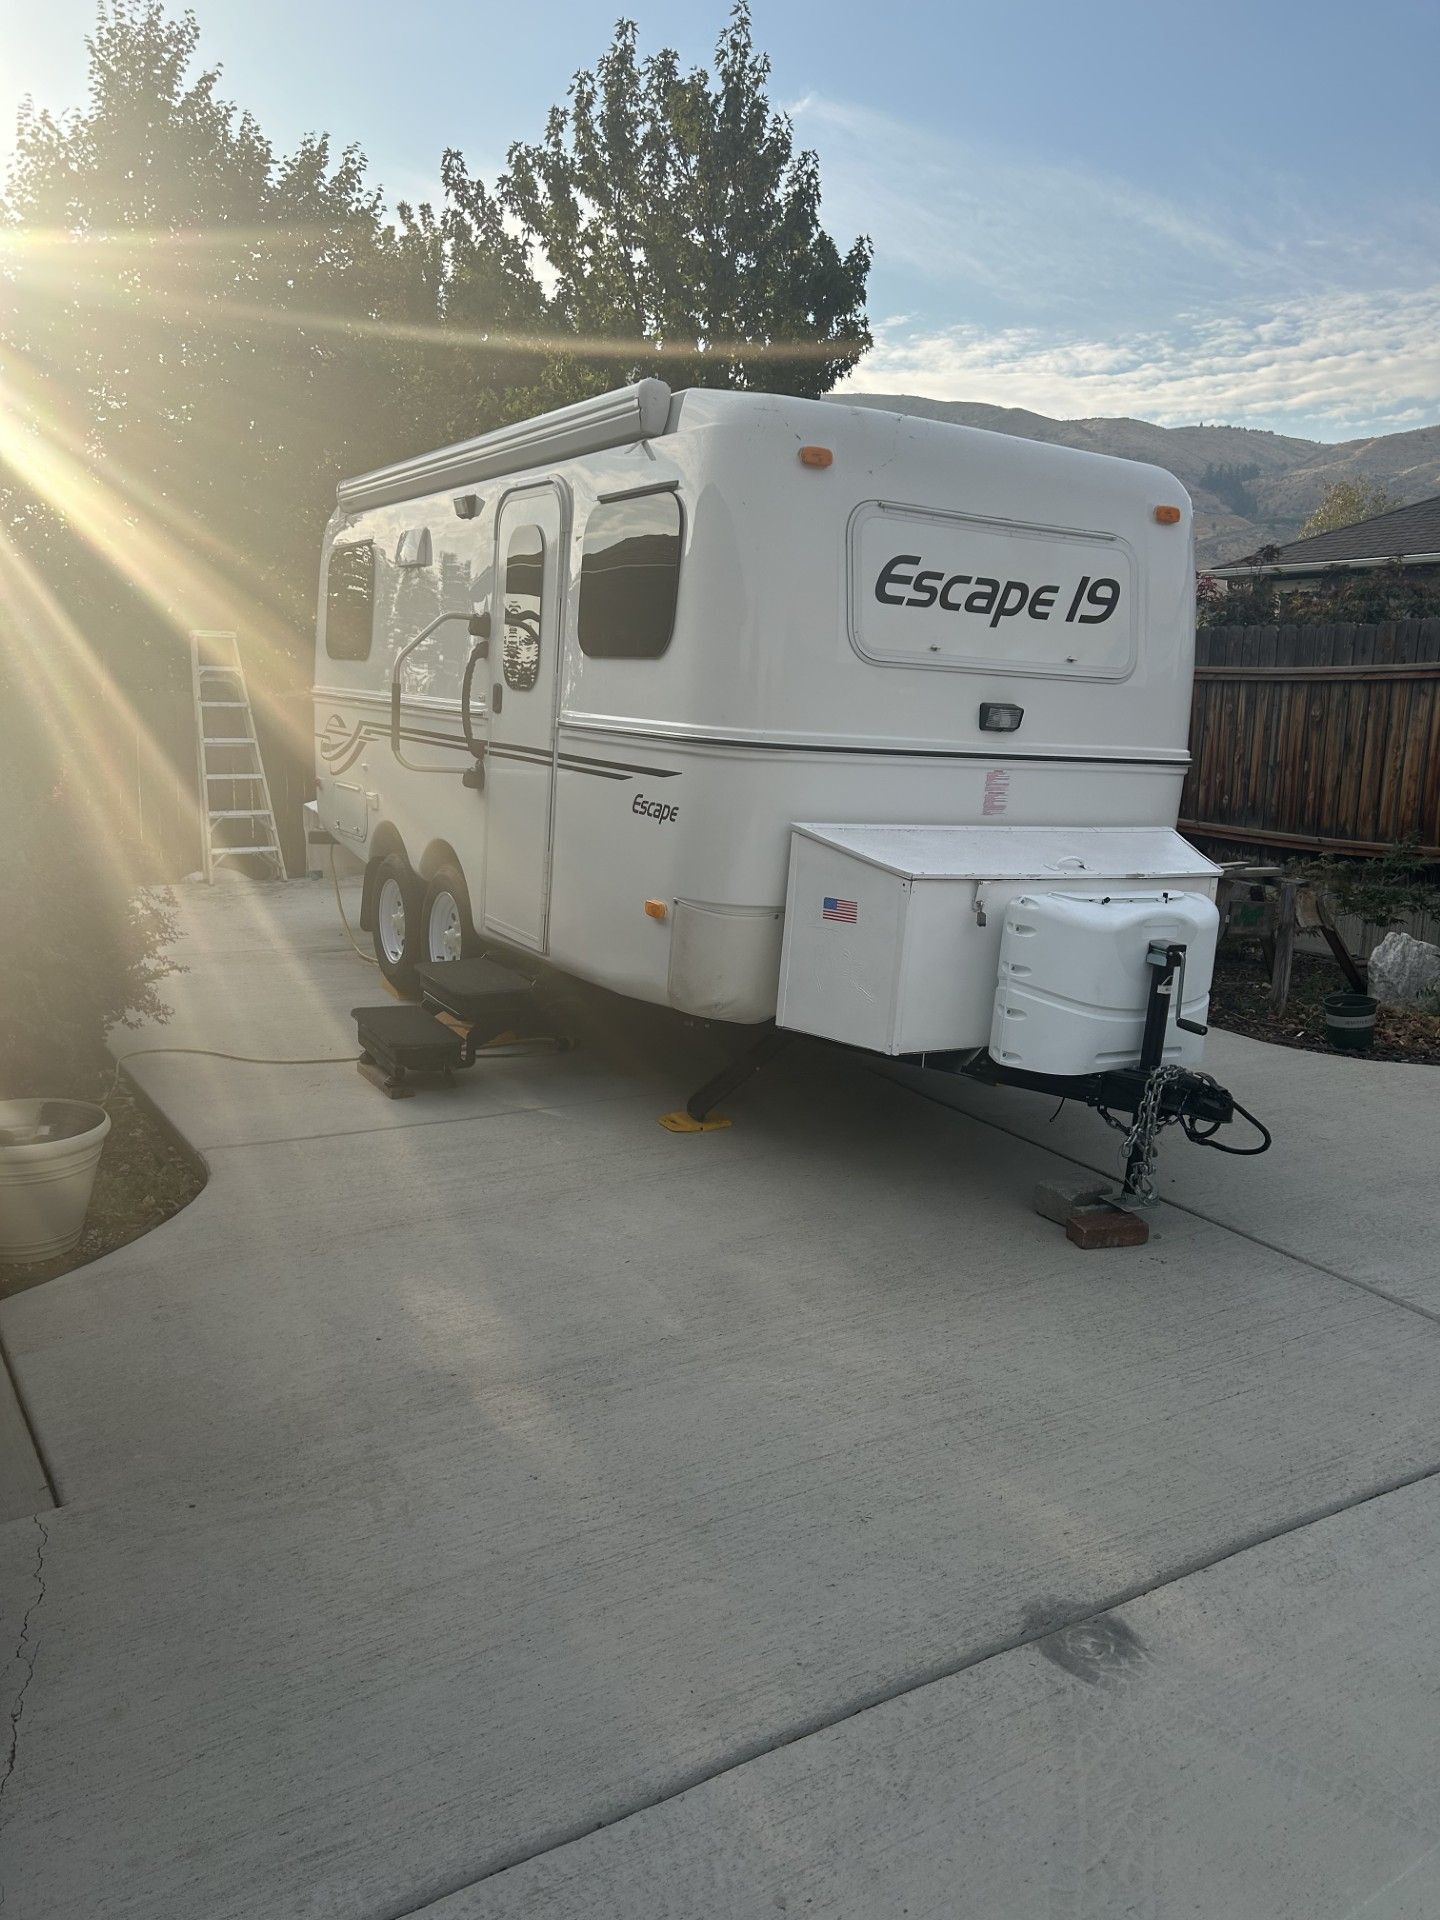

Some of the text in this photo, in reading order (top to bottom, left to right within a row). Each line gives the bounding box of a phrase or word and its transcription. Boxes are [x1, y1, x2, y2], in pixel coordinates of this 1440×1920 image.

[875, 555, 1121, 628] Escape 19
[632, 793, 680, 825] Escape
